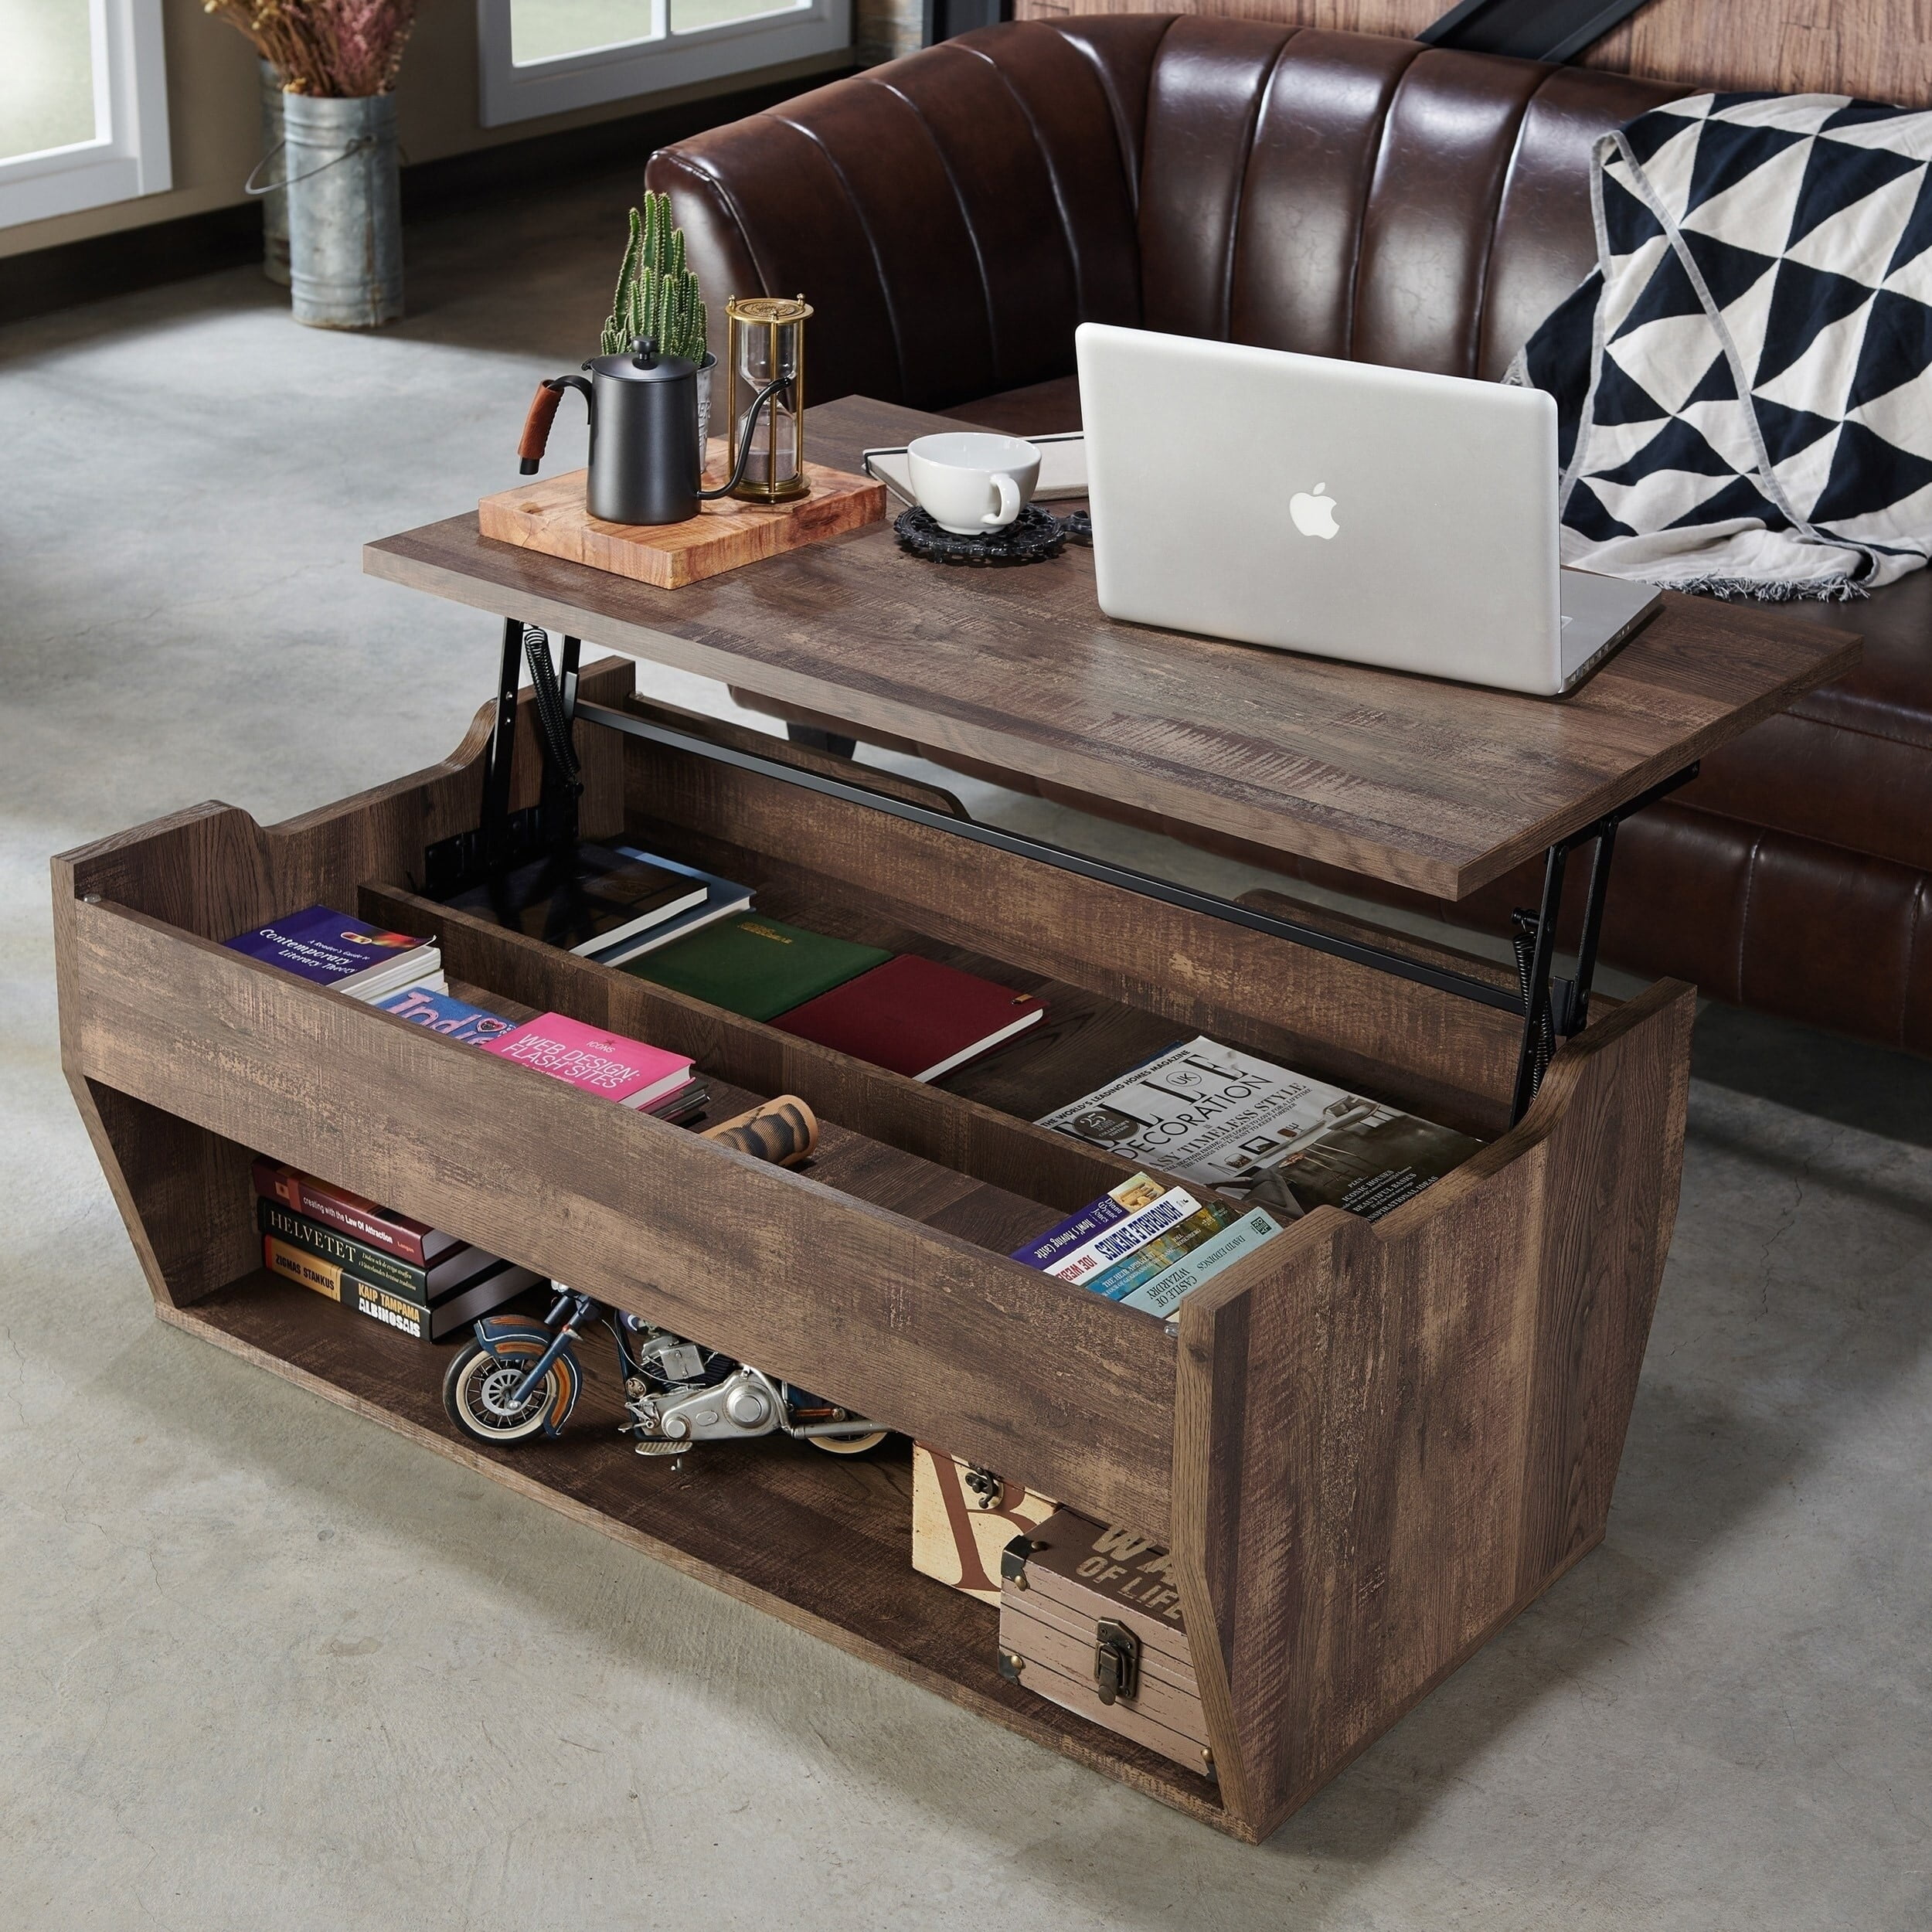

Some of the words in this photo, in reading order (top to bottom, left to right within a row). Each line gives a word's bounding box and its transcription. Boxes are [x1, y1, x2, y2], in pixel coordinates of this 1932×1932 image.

[260, 929, 352, 965] Contemporary
[278, 949, 322, 967] Literary
[321, 963, 357, 974] Theory
[519, 1033, 566, 1055] WEB
[562, 1049, 640, 1081] DESIGN:
[587, 1039, 616, 1053] ICONS
[502, 1043, 570, 1071] FLASH
[564, 1064, 624, 1088] SITES
[1172, 1073, 1198, 1085] UK
[1039, 1118, 1058, 1128] THE
[1056, 1100, 1093, 1120] WORLD'S
[1090, 1083, 1125, 1103] LEADING
[1123, 1070, 1152, 1087] HOMES
[1151, 1049, 1191, 1073] MAGAZINE
[1080, 1113, 1106, 1128] 25
[1109, 1074, 1274, 1162] DECORATION
[1149, 1151, 1181, 1167] ASY
[1177, 1109, 1259, 1153] TIMELESS
[1254, 1082, 1307, 1112] STYLE
[1179, 1151, 1202, 1166] SECTION
[1221, 1132, 1235, 1142] THE
[1257, 1113, 1273, 1123] LOVE
[1271, 1105, 1284, 1114] FOR
[1287, 1088, 1313, 1104] LIFETIME
[1182, 1160, 1196, 1169] THE
[1195, 1149, 1216, 1163] THINGS
[1259, 1117, 1273, 1128] KEEP
[1272, 1102, 1298, 1119] FOREVER
[1342, 1184, 1369, 1202] ICONIC
[1366, 1168, 1395, 1187] HOUSES
[1352, 1186, 1394, 1213] BEAUTIFUL
[1391, 1172, 1417, 1189] BASICS
[1416, 1175, 1439, 1191] IDEAS
[303, 1196, 325, 1214] creating
[324, 1206, 336, 1218] with
[335, 1210, 345, 1222] the
[345, 1214, 358, 1228] Law
[357, 1220, 365, 1231] Of
[365, 1223, 393, 1244] Attraction
[1090, 1208, 1109, 1223] Jones
[1097, 1201, 1118, 1219] Wynne
[1104, 1197, 1123, 1214] Diana
[1128, 1200, 1183, 1240] HONORABLE
[270, 1209, 357, 1264] HELVETET
[1049, 1230, 1078, 1248] Moving
[1071, 1218, 1096, 1236] Howl's
[1033, 1243, 1056, 1259] Castle
[1094, 1226, 1141, 1261] ENEMIES
[1226, 1235, 1246, 1251] DAVID
[276, 1253, 301, 1274] ZIGMAS
[303, 1267, 335, 1291] STANKUS
[1077, 1254, 1098, 1271] JOE
[1196, 1247, 1228, 1271] EDDINGS
[1102, 1277, 1117, 1288] THE
[1114, 1267, 1130, 1280] HEIR
[1146, 1267, 1190, 1300] WIZARDRY
[1169, 1275, 1198, 1300] CASTLE
[358, 1282, 378, 1302] KAIP
[379, 1292, 420, 1323] TAMPAMA
[1155, 1294, 1170, 1308] OF
[359, 1297, 421, 1338] ALBINOSAIS
[1076, 1556, 1128, 1583] OF
